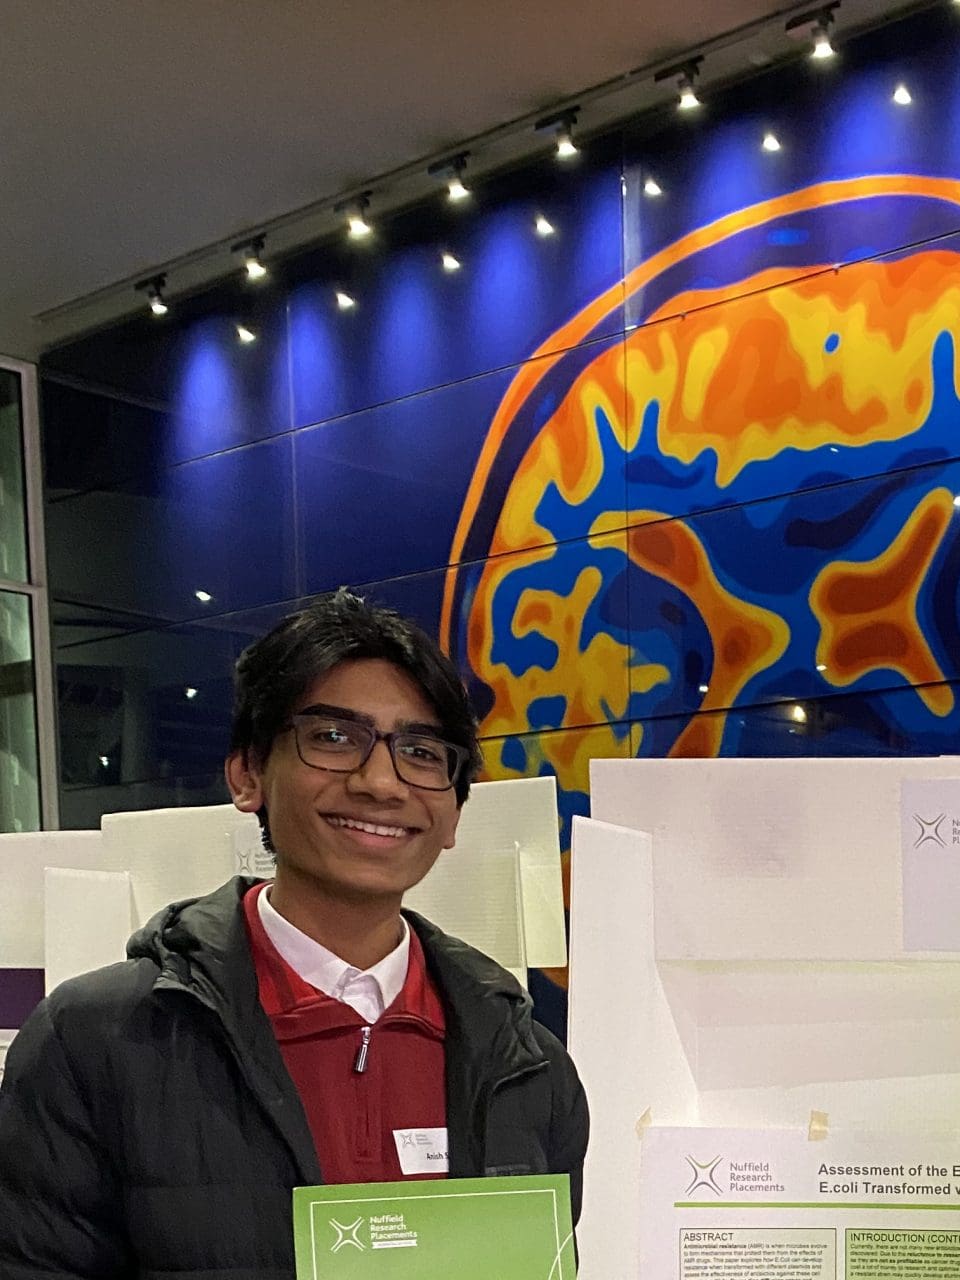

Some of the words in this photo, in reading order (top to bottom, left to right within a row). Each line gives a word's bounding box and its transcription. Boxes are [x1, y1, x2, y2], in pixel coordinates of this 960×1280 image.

[730, 1162, 769, 1172] Nuffield
[818, 1163, 904, 1176] Assessment
[908, 1164, 922, 1176] of
[926, 1165, 948, 1177] the
[730, 1172, 772, 1182] Research
[730, 1182, 785, 1192] Placements
[819, 1181, 858, 1194] E.coli
[863, 1181, 951, 1195] Transformed
[370, 1215, 404, 1224] Nuffield
[370, 1222, 407, 1232] Research
[371, 1231, 418, 1241] Placements
[684, 1232, 734, 1242] ABSTRACT
[850, 1233, 925, 1243] INTRODUCTION
